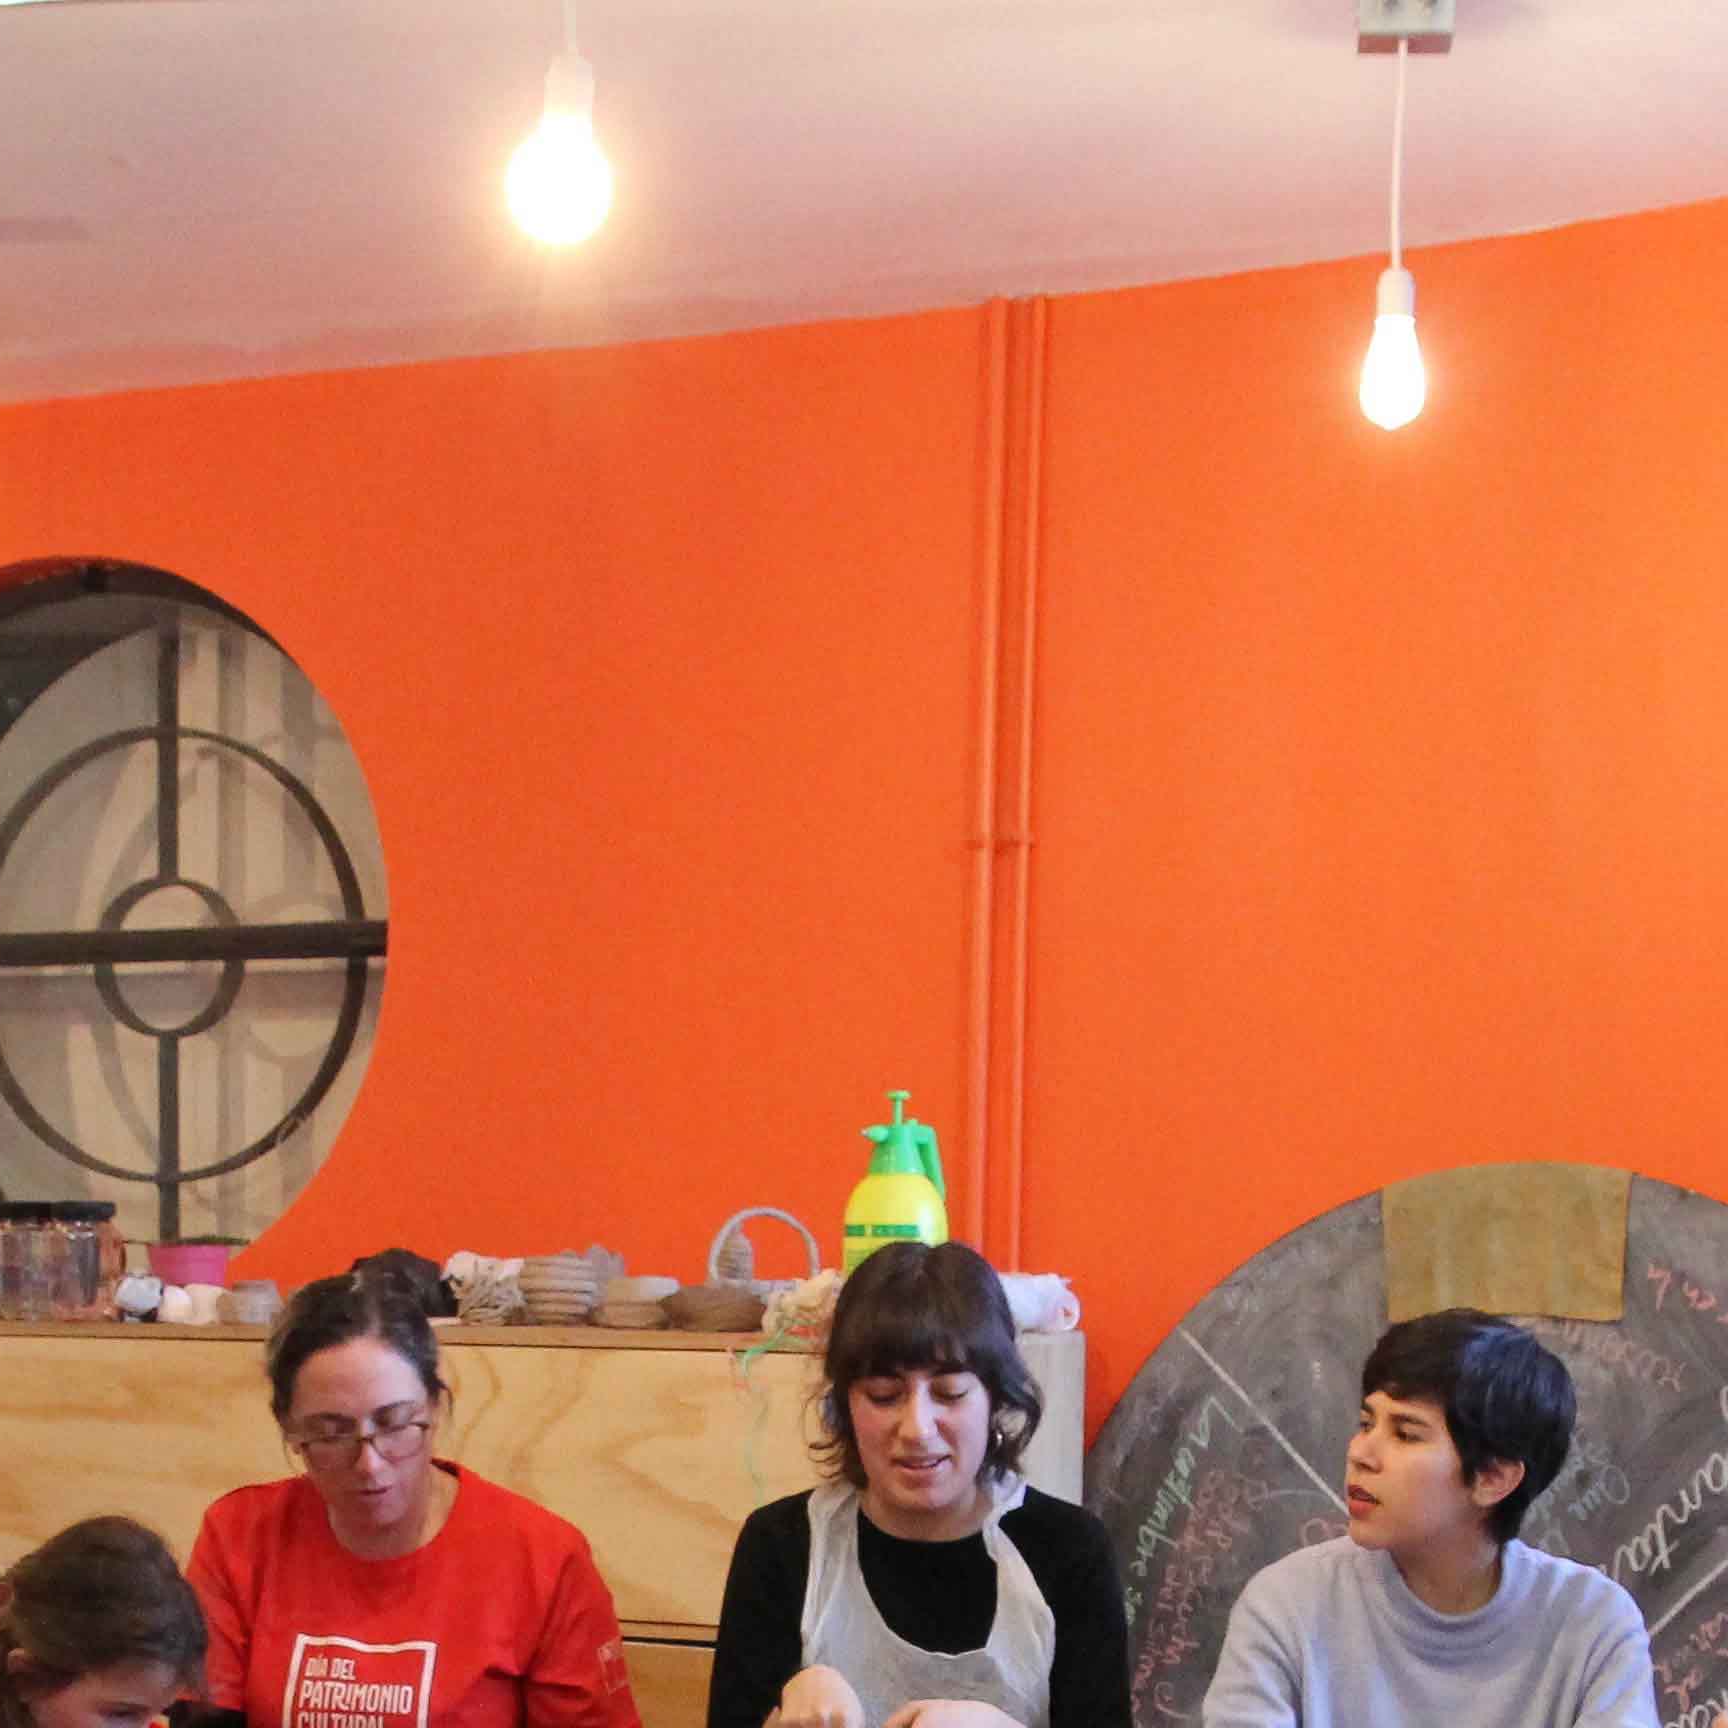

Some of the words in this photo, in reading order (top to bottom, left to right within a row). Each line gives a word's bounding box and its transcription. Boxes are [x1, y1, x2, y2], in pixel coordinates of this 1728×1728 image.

[304, 1653, 328, 1677] DÍA
[330, 1658, 356, 1680] DEL
[298, 1680, 414, 1714] PATRIMONIO
